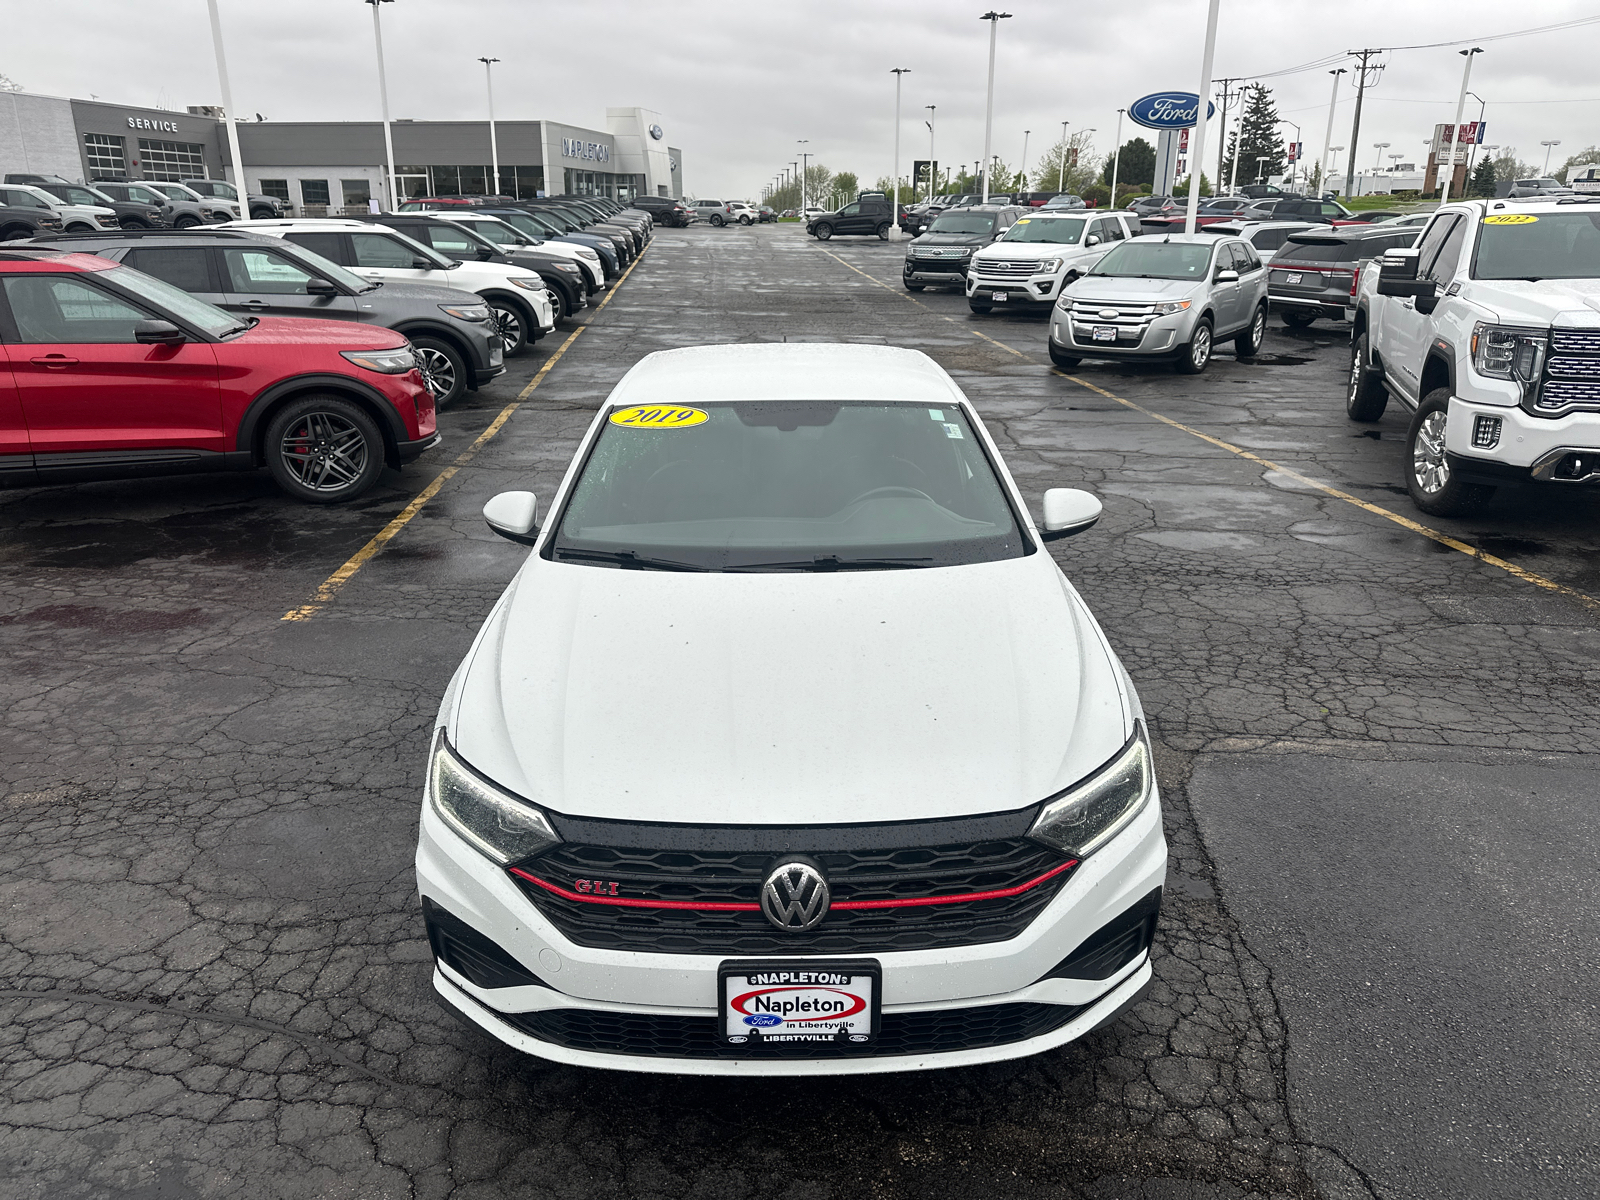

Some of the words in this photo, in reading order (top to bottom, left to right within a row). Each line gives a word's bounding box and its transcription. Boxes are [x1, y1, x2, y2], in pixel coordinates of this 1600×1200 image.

[1147, 98, 1199, 121] Ford
[128, 116, 178, 133] SERVICE
[562, 137, 610, 163] NAPLETON
[621, 409, 694, 424] 2019
[574, 879, 619, 895] GLI
[757, 972, 842, 985] NAPLETON
[755, 996, 844, 1016] Napleton
[750, 1015, 776, 1026] Ford
[786, 1021, 796, 1029] in
[798, 1021, 855, 1030] Libertyville
[763, 1034, 835, 1042] LIBERTYVILLE
